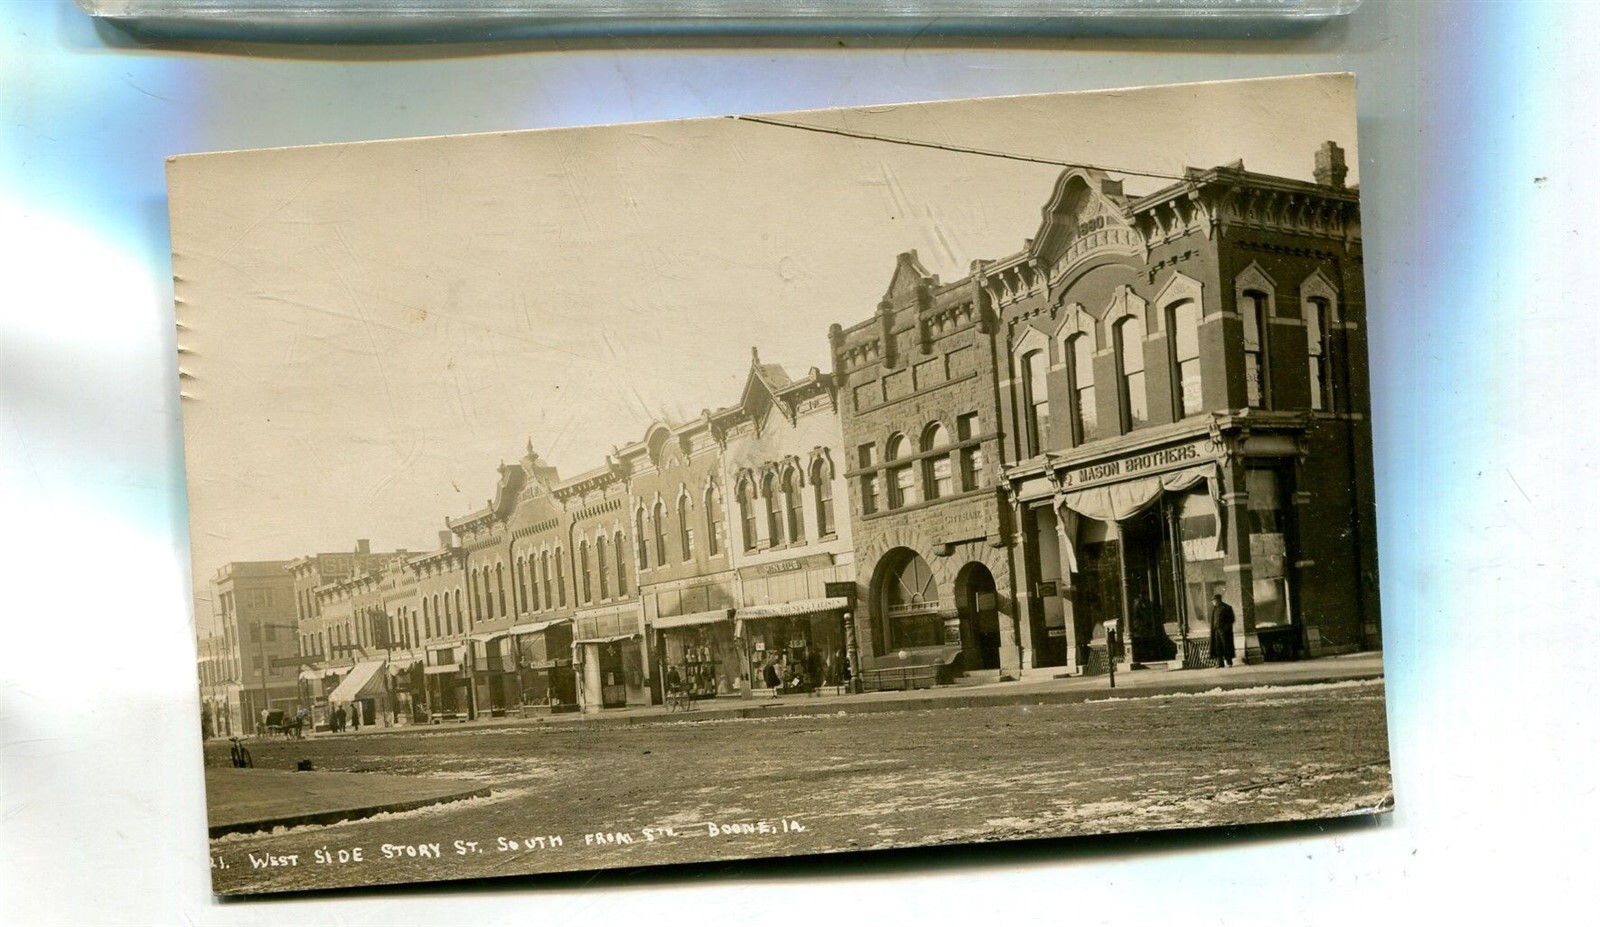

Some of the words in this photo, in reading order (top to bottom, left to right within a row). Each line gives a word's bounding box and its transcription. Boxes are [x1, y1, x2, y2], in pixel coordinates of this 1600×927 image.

[1079, 461, 1120, 483] MASON
[1125, 444, 1201, 473] BROTHERS.
[248, 852, 299, 869] WEST
[314, 846, 363, 864] SIDE
[381, 842, 440, 859] STORY
[454, 840, 482, 856] ST.
[585, 831, 633, 846] FROM
[707, 821, 777, 837] BOONE,
